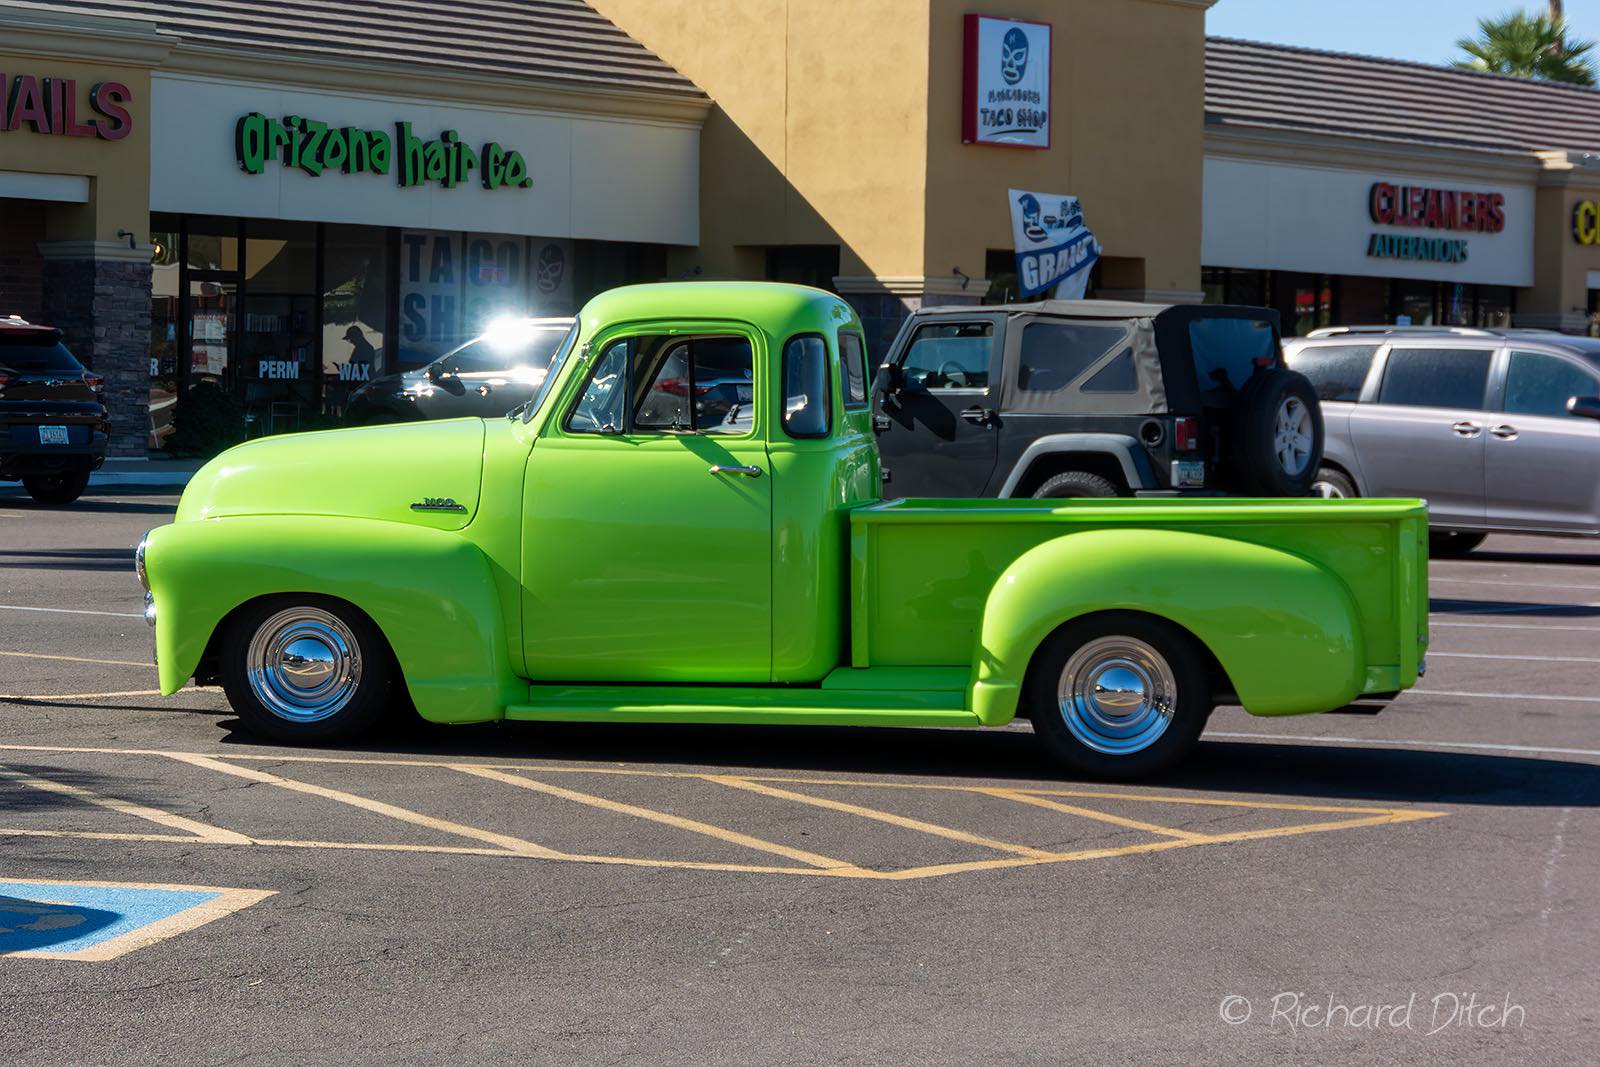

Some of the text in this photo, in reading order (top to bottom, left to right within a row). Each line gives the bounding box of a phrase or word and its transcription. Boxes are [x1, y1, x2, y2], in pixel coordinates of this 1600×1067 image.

[980, 108, 1047, 128] TACO SHOP
[396, 121, 479, 189] hair
[1370, 182, 1505, 233] CLEANERS
[403, 234, 520, 288] TACO
[1367, 233, 1469, 263] ALTERATIONS
[258, 360, 299, 379] PERM
[339, 362, 370, 381] WAX
